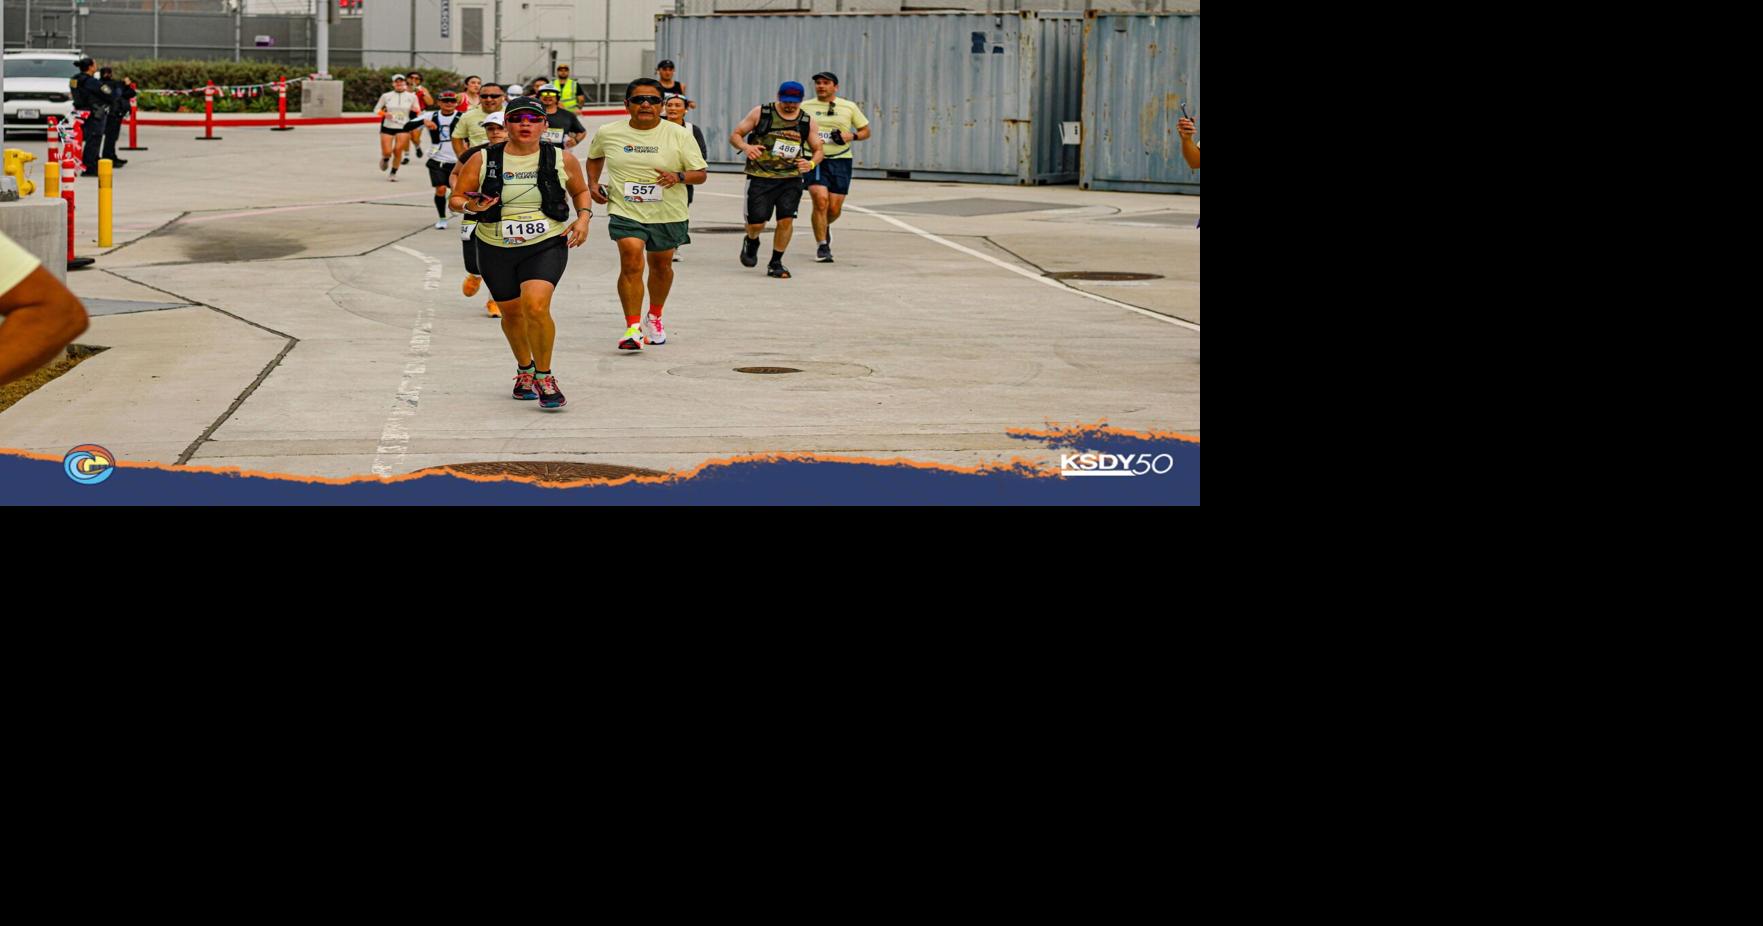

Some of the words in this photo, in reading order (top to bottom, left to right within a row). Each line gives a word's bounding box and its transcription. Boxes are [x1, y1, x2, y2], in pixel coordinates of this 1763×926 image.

[779, 144, 796, 153] 486
[632, 185, 656, 195] 557
[506, 222, 546, 236] 1188
